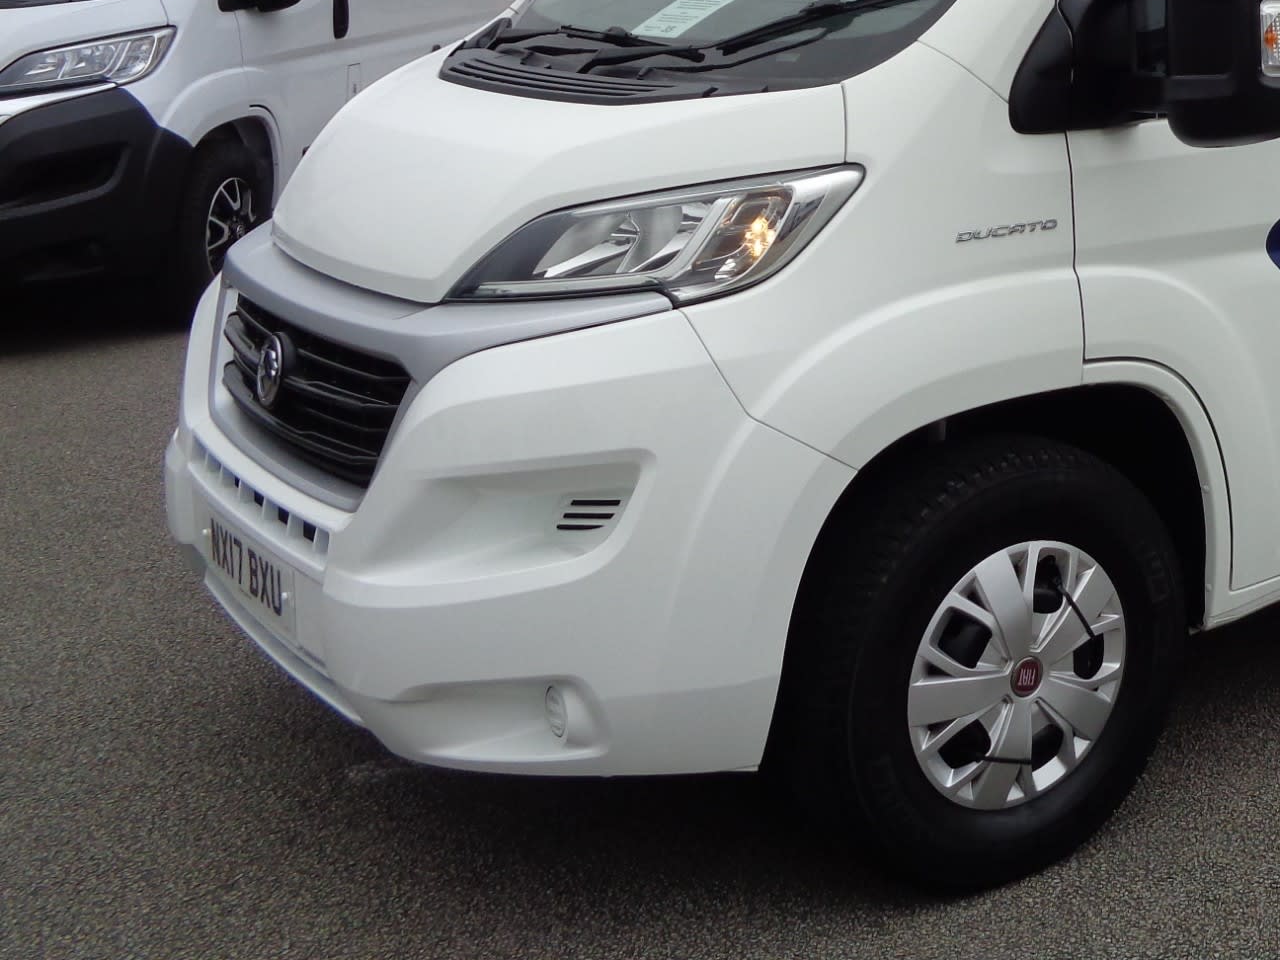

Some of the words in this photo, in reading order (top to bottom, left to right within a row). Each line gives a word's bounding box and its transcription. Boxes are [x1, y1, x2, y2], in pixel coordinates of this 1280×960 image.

[955, 219, 1058, 243] DUCATO
[210, 517, 244, 586] NX17
[247, 547, 282, 617] BXU
[1017, 667, 1036, 687] FIAT
